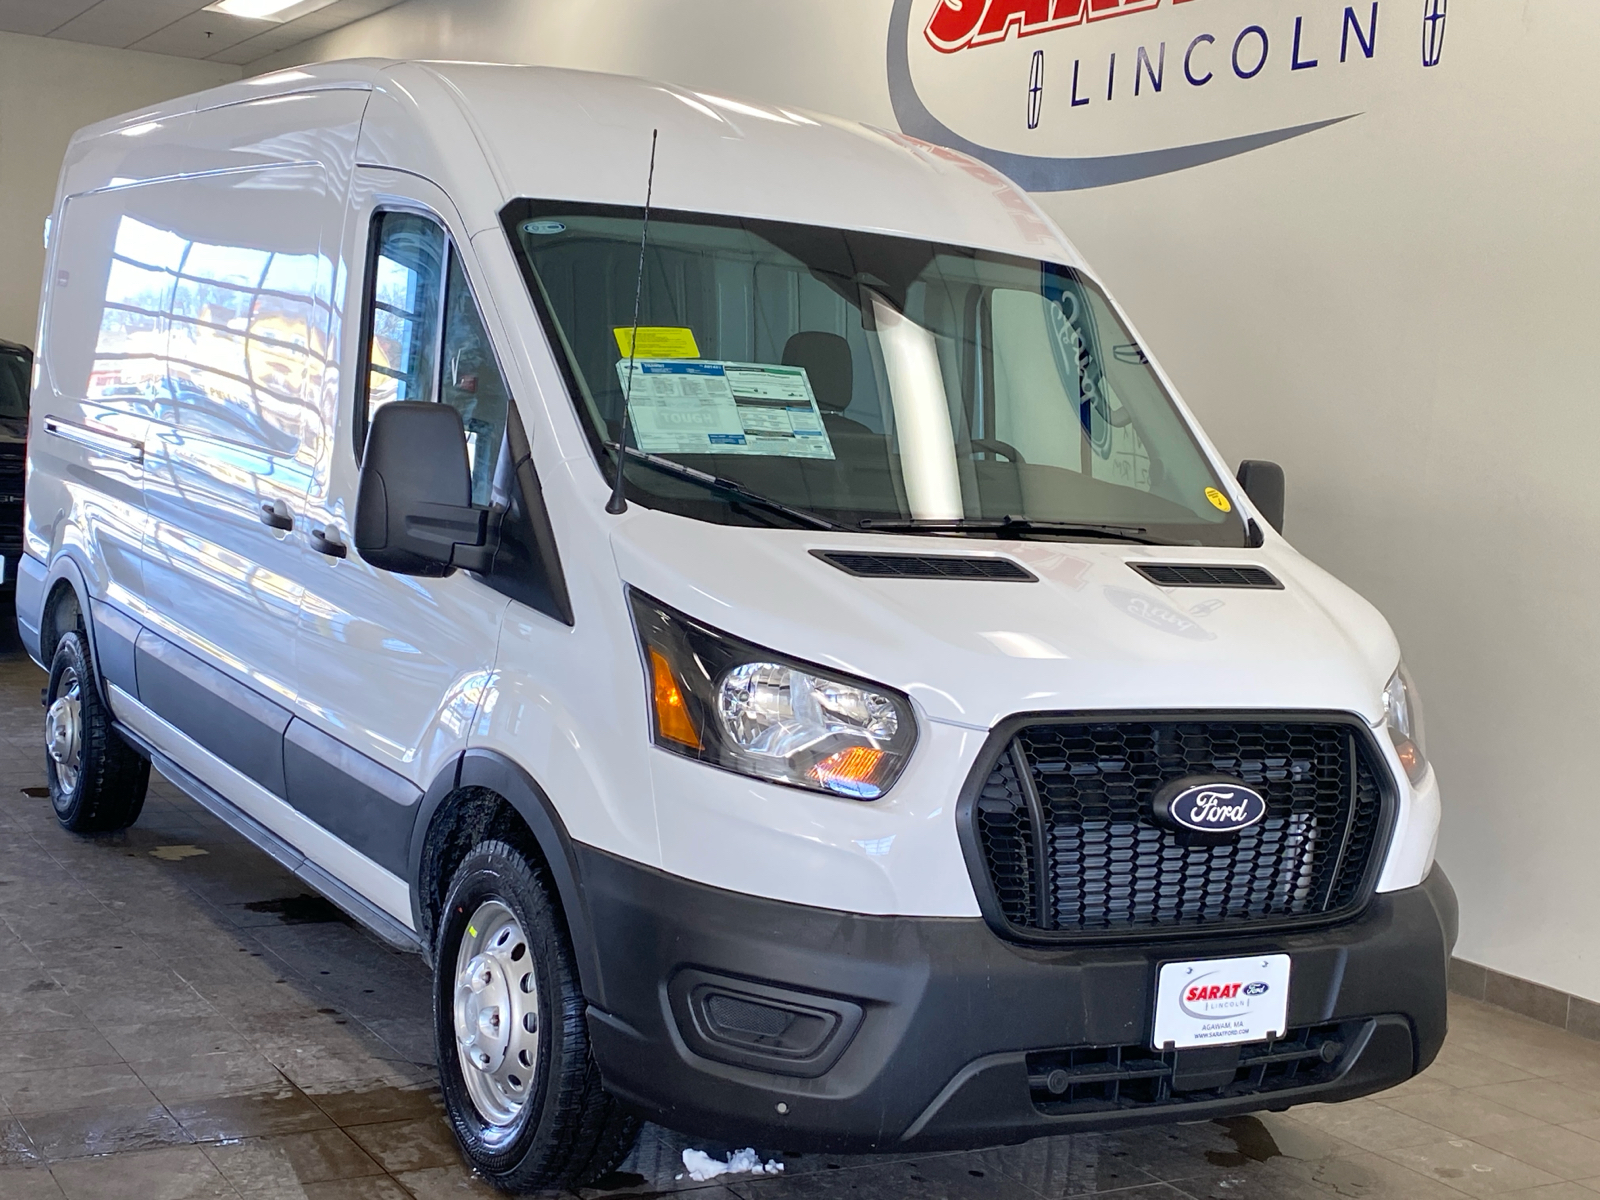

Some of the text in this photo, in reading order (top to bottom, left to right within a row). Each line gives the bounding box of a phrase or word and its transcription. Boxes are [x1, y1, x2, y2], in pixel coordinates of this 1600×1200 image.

[1070, 1, 1379, 108] LINCOLN
[660, 412, 714, 425] TOUGH
[1189, 790, 1249, 823] Ford
[1186, 982, 1267, 1001] SARAT Ford
[1210, 1001, 1245, 1009] LINCOLN
[1201, 1020, 1244, 1031] AGAWAM, MA
